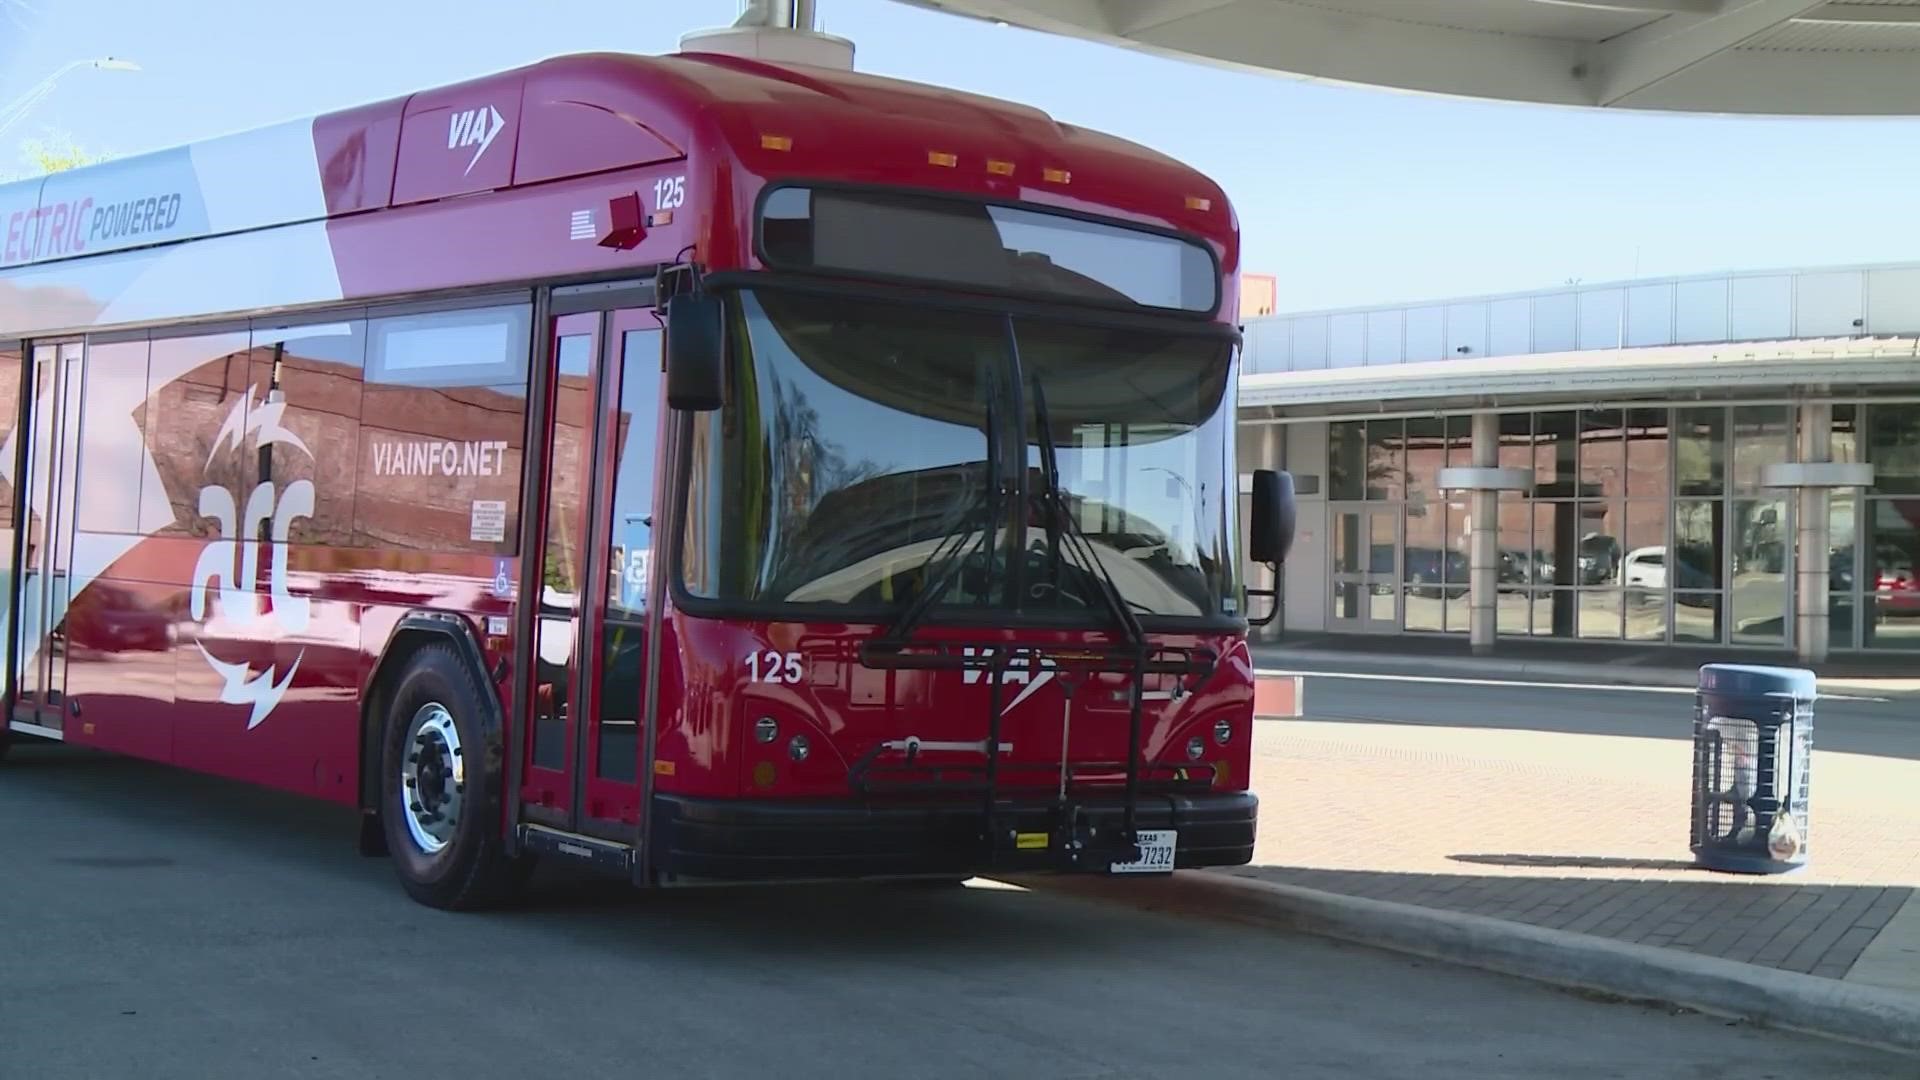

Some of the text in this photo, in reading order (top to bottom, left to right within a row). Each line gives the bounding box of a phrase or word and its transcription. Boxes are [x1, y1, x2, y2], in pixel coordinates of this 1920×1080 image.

[448, 108, 488, 150] VIA
[654, 176, 685, 211] 125
[0, 193, 181, 263] ECTRIC POWERED
[372, 441, 506, 477] VIAINFO.NET
[744, 652, 803, 684] 125
[1137, 833, 1158, 842] EXAS
